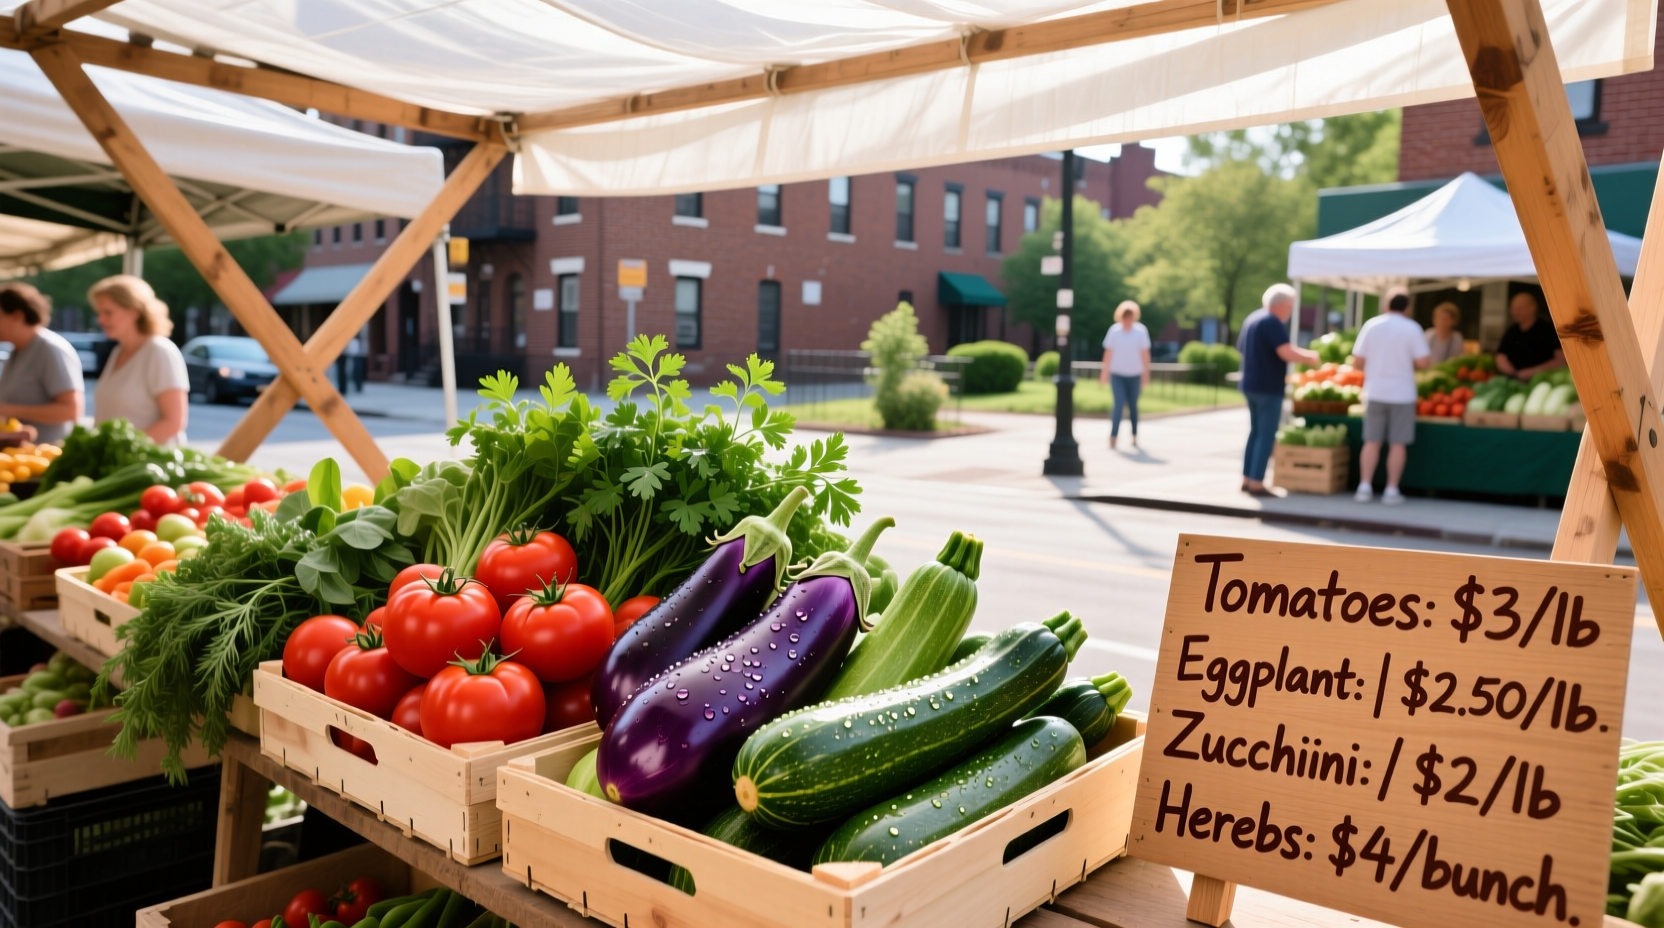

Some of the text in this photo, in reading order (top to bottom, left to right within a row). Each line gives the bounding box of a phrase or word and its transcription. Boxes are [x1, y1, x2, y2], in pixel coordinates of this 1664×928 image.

[1194, 552, 1601, 649] Tomatoes: $3/lb
[1177, 634, 1365, 709] Eggplant:
[1400, 660, 1609, 733] $2.50/lb.
[1162, 709, 1372, 786] Zucchiini:
[1412, 743, 1562, 820] $2/lb
[1154, 779, 1581, 928] Herebs: $4/bunch.
